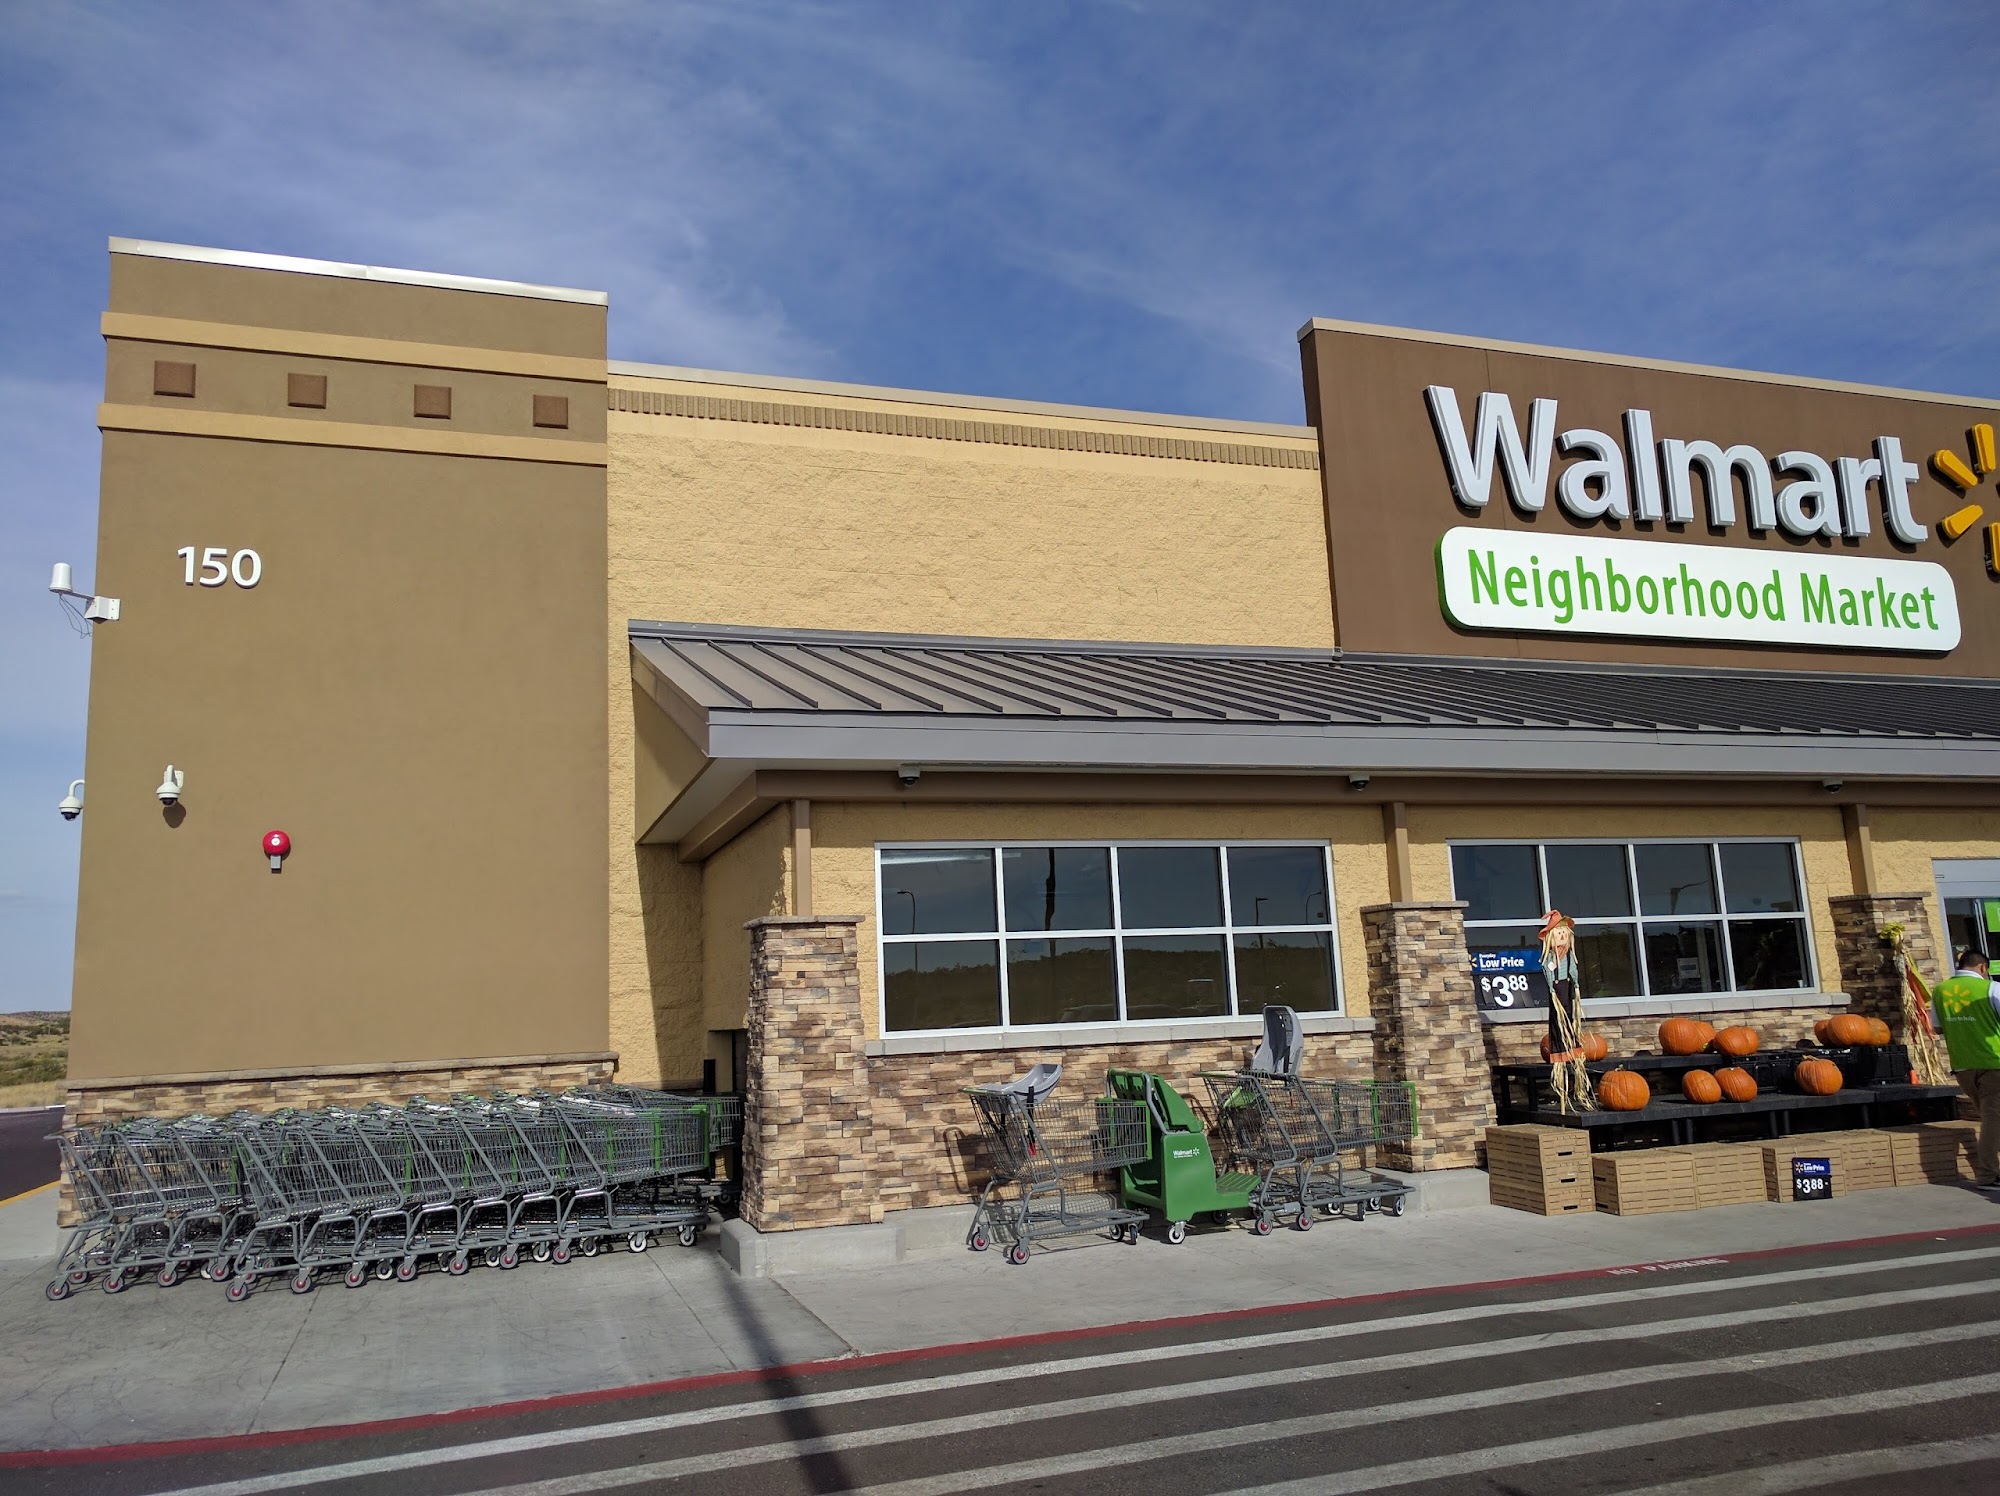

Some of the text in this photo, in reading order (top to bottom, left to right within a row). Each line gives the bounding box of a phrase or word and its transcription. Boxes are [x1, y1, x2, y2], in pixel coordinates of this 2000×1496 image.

[1425, 385, 1928, 545] Walmart
[177, 545, 263, 590] 150
[1468, 548, 1938, 631] Neighborhood Market
[1480, 956, 1525, 968] Low Price
